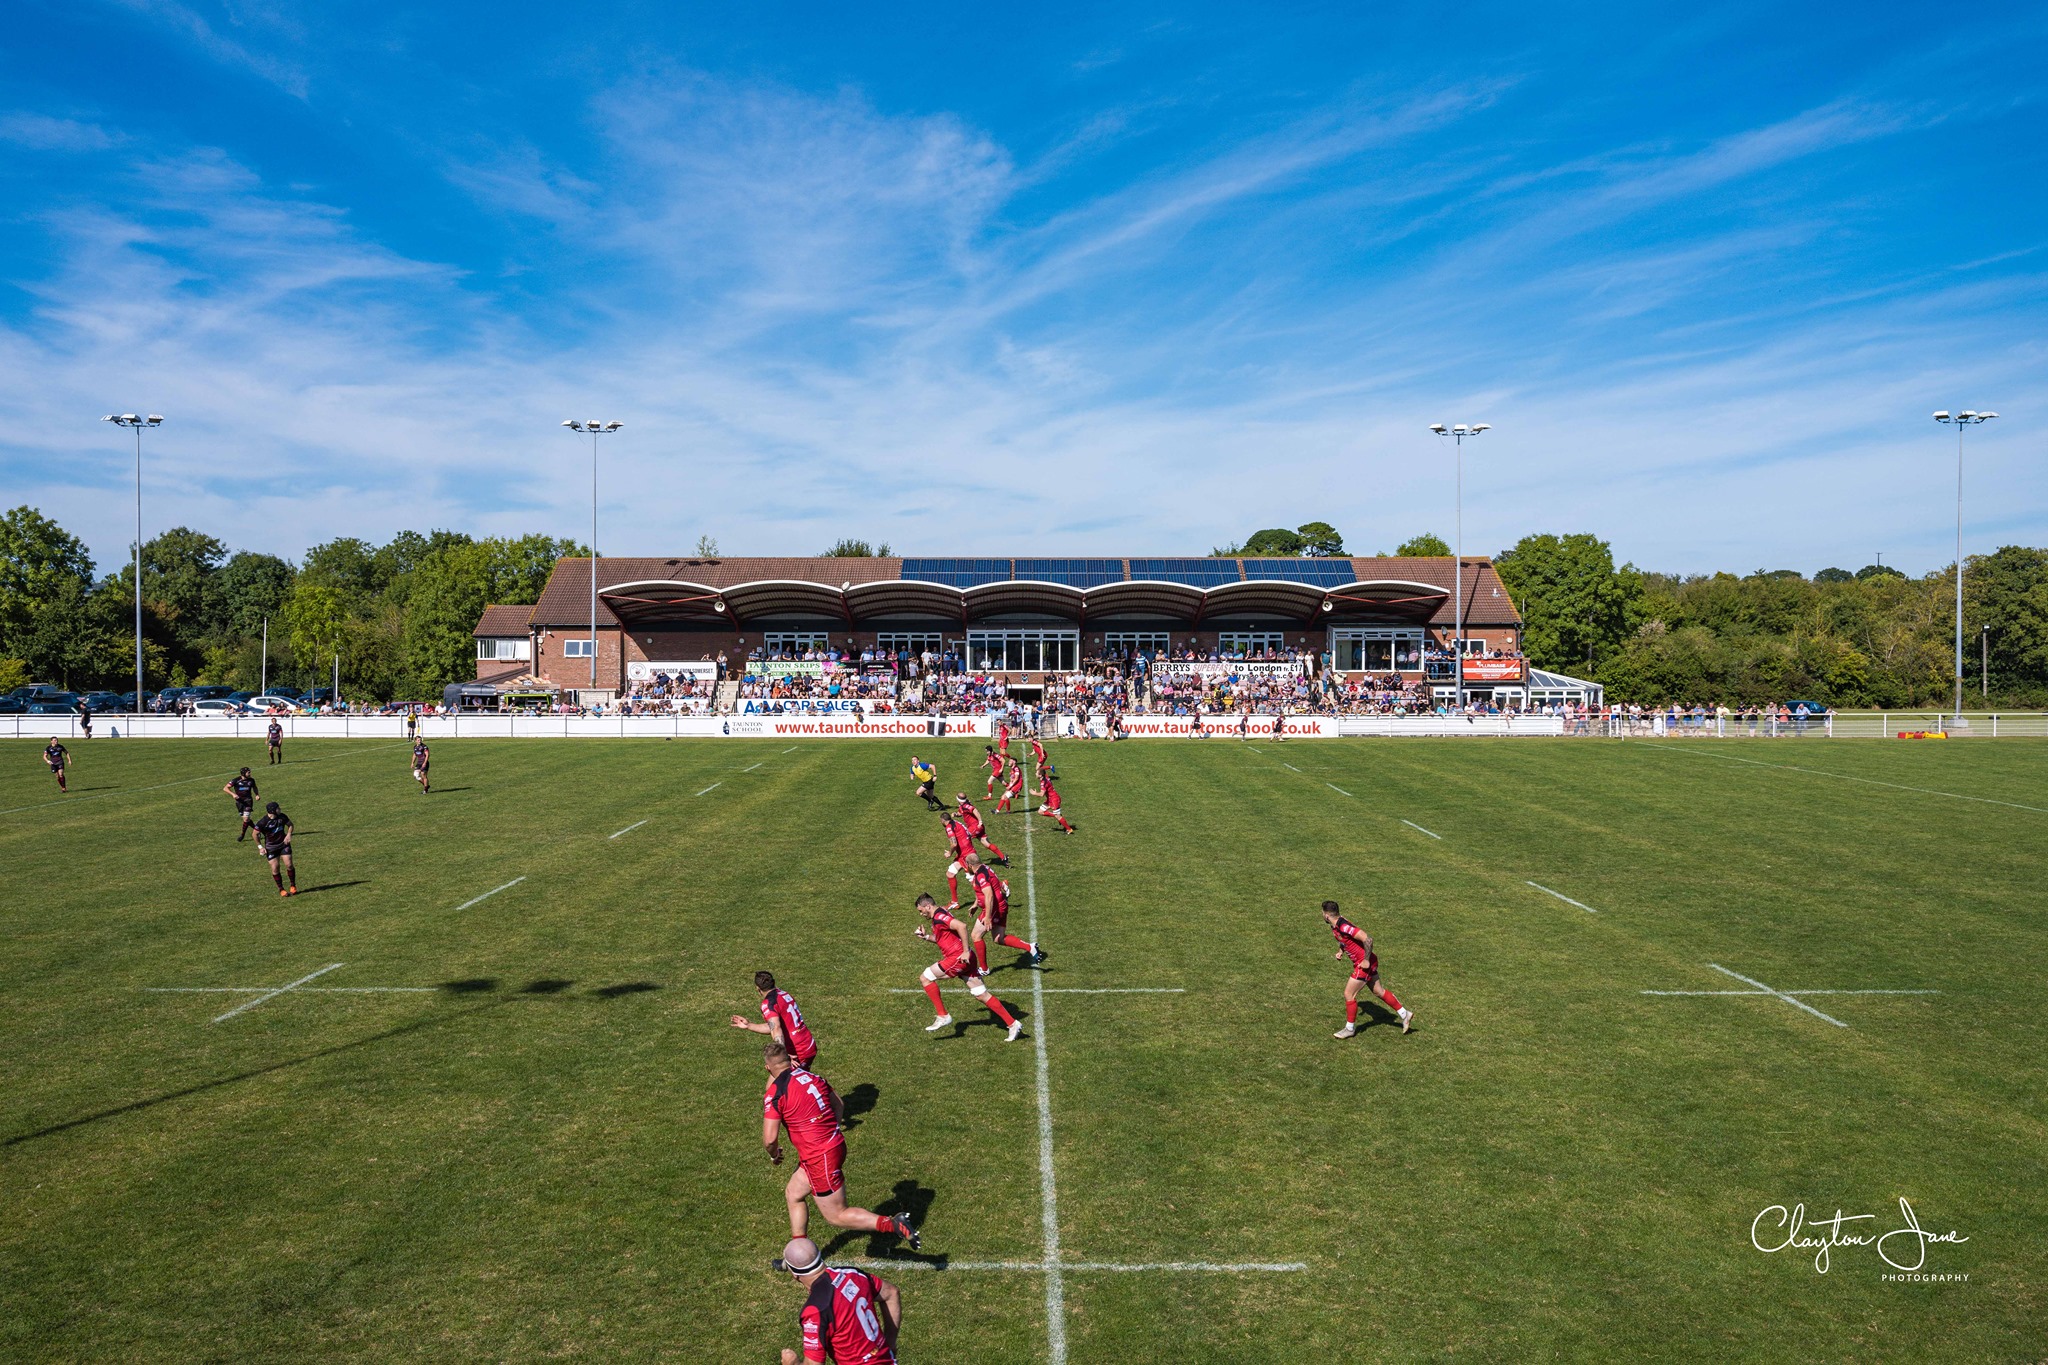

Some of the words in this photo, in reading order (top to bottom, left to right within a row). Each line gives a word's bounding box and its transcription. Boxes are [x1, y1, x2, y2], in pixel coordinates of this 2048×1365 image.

[1153, 664, 1191, 672] BERRYS
[1193, 664, 1233, 672] SUPERFAST
[1247, 664, 1282, 672] London
[775, 719, 977, 734] www.tauntonschooo.uk
[807, 1083, 825, 1110] 1
[856, 1296, 879, 1342] 6
